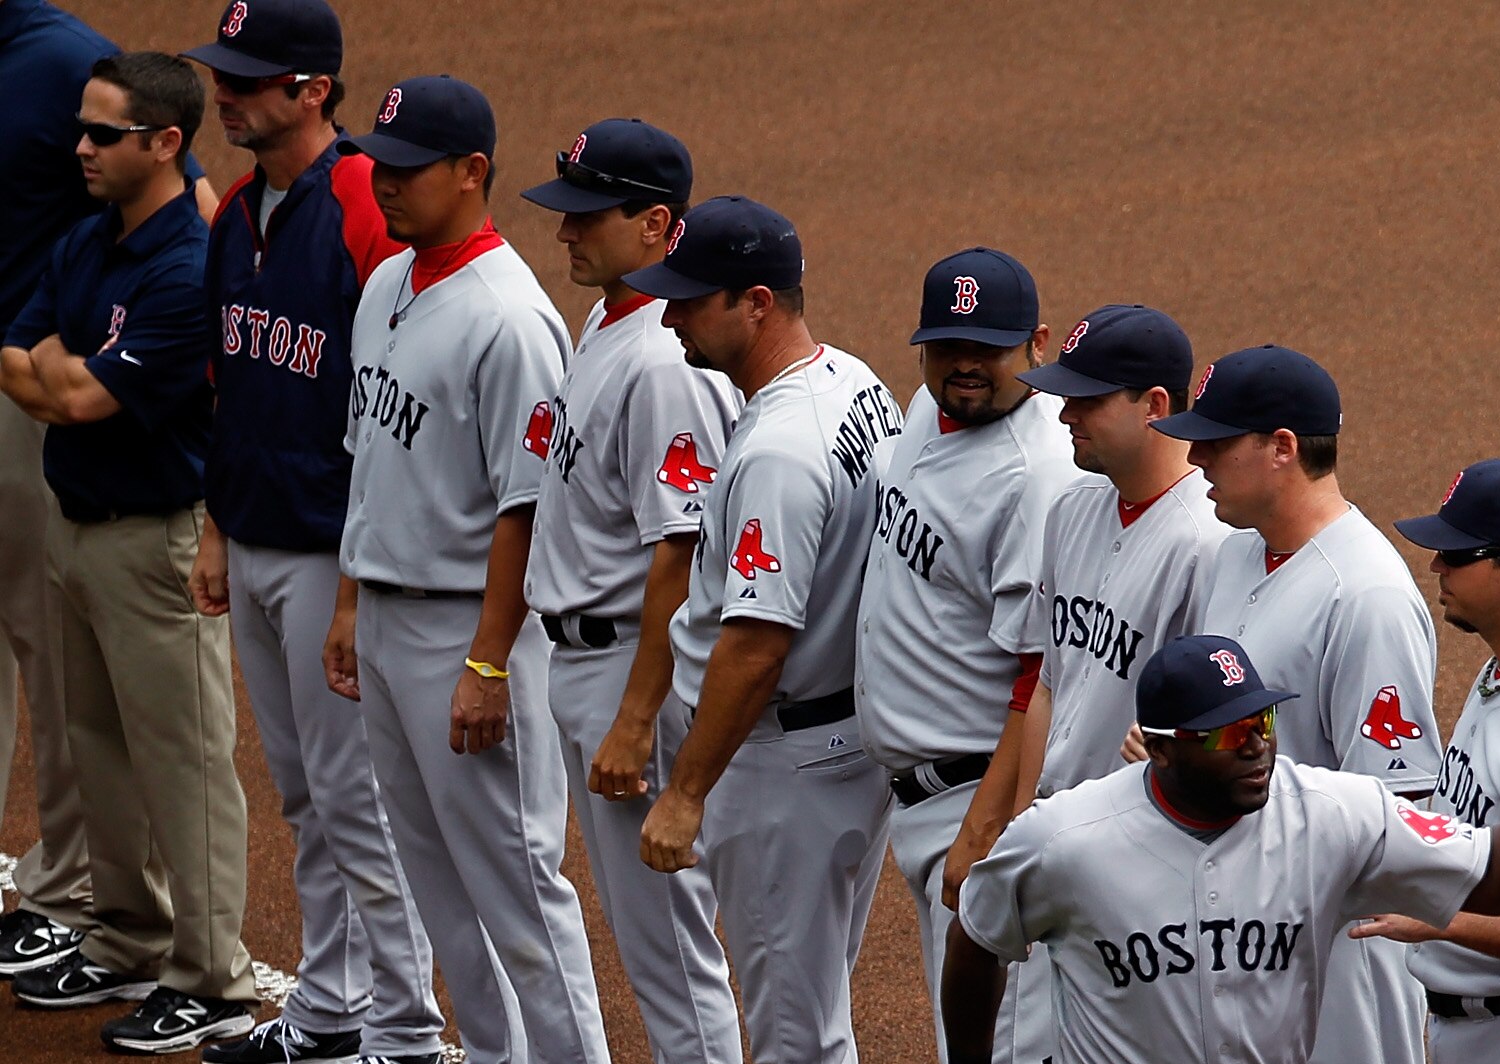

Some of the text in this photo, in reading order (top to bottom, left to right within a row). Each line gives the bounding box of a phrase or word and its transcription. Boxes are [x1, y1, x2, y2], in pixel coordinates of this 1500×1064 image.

[951, 276, 980, 314] B
[221, 304, 326, 378] STON
[1210, 650, 1245, 686] B
[1437, 745, 1494, 828] STON
[1094, 918, 1304, 988] BOSTON
